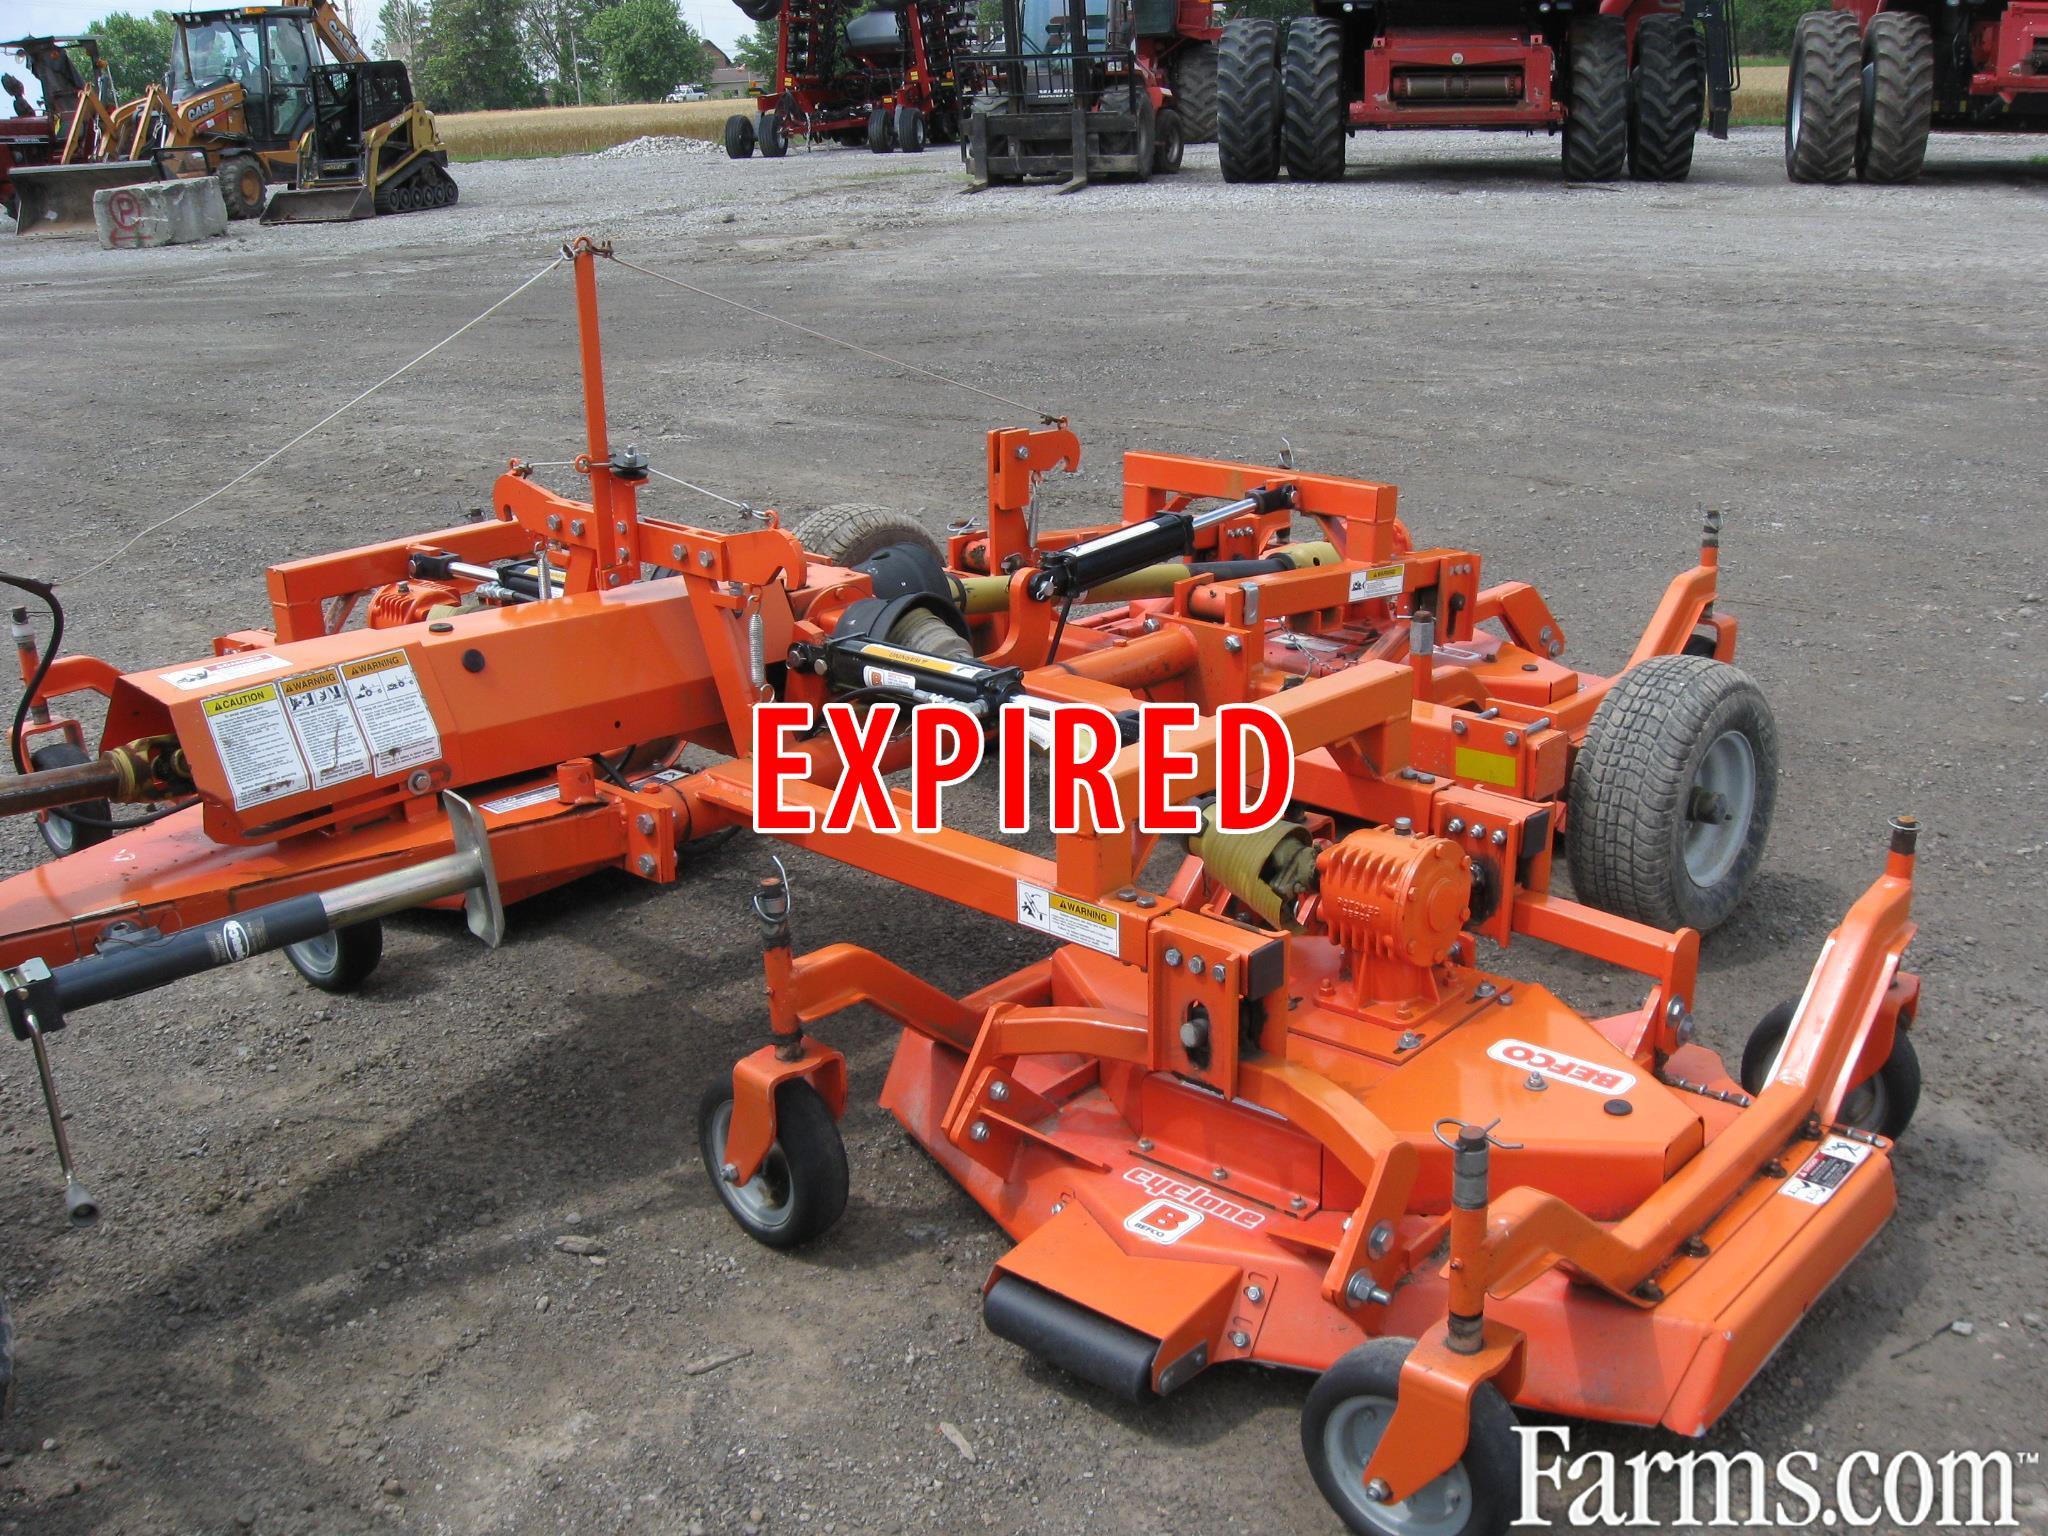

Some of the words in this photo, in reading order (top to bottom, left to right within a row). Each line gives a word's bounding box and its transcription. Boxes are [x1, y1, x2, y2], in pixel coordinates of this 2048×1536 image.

[328, 20, 358, 59] CASE
[187, 99, 215, 121] CASE
[359, 656, 400, 674] WARNING
[293, 673, 336, 691] WARNING
[222, 691, 264, 709] CAUTION
[1067, 902, 1107, 923] WARNING
[1502, 1046, 1623, 1089] BEFCO
[1123, 1167, 1265, 1229] cyclone
[1140, 1204, 1190, 1231] B
[1133, 1222, 1165, 1238] BEFCO
